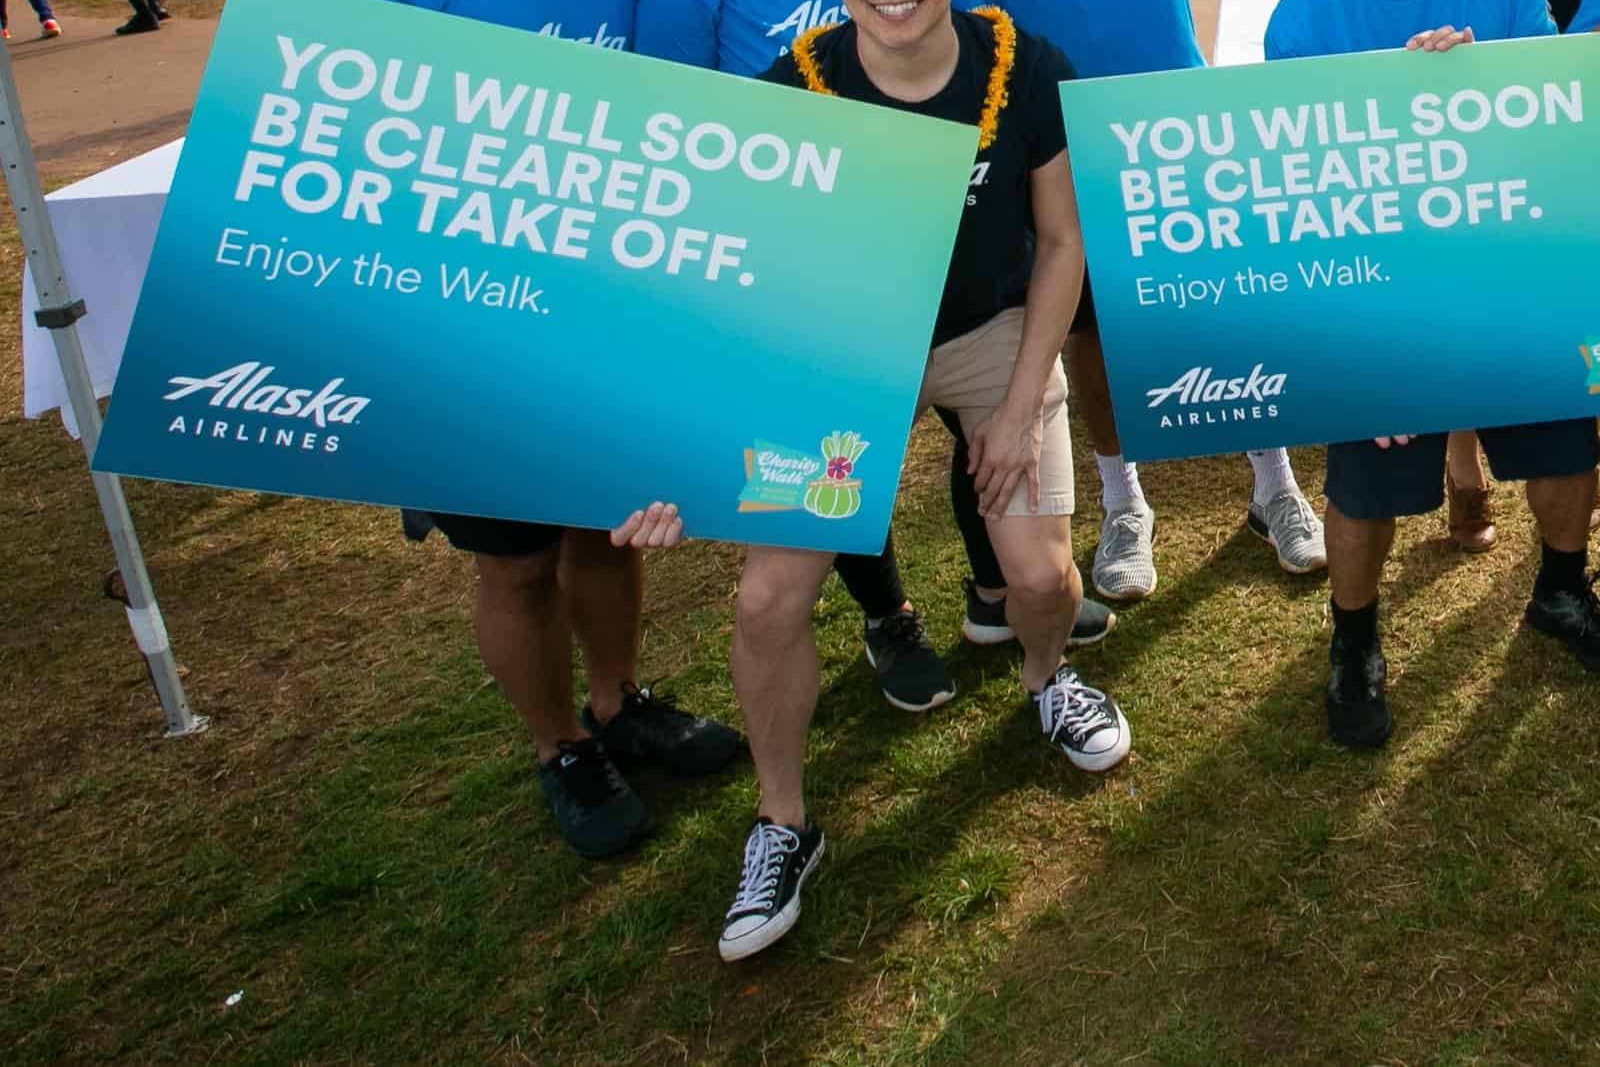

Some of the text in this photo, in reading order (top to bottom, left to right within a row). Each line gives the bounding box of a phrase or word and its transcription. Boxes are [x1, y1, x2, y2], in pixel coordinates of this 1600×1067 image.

[277, 35, 842, 193] YOU WILL SOON
[1109, 81, 1583, 165] YOU WILL SOON
[250, 92, 691, 217] BE CLEARED
[1119, 140, 1468, 212] BE CLEARED
[233, 149, 754, 287] FOR TAKE OFF.
[1125, 179, 1543, 258] FOR TAKE OFF.
[215, 227, 550, 315] Enjoy the Walk.
[1135, 255, 1391, 309] Enjoy the Walk.
[162, 361, 371, 429] Alaska
[1145, 362, 1288, 408] Alaska
[1160, 404, 1279, 429] AIRLINES
[167, 415, 340, 453] AIRLINES
[758, 451, 820, 475] Charity
